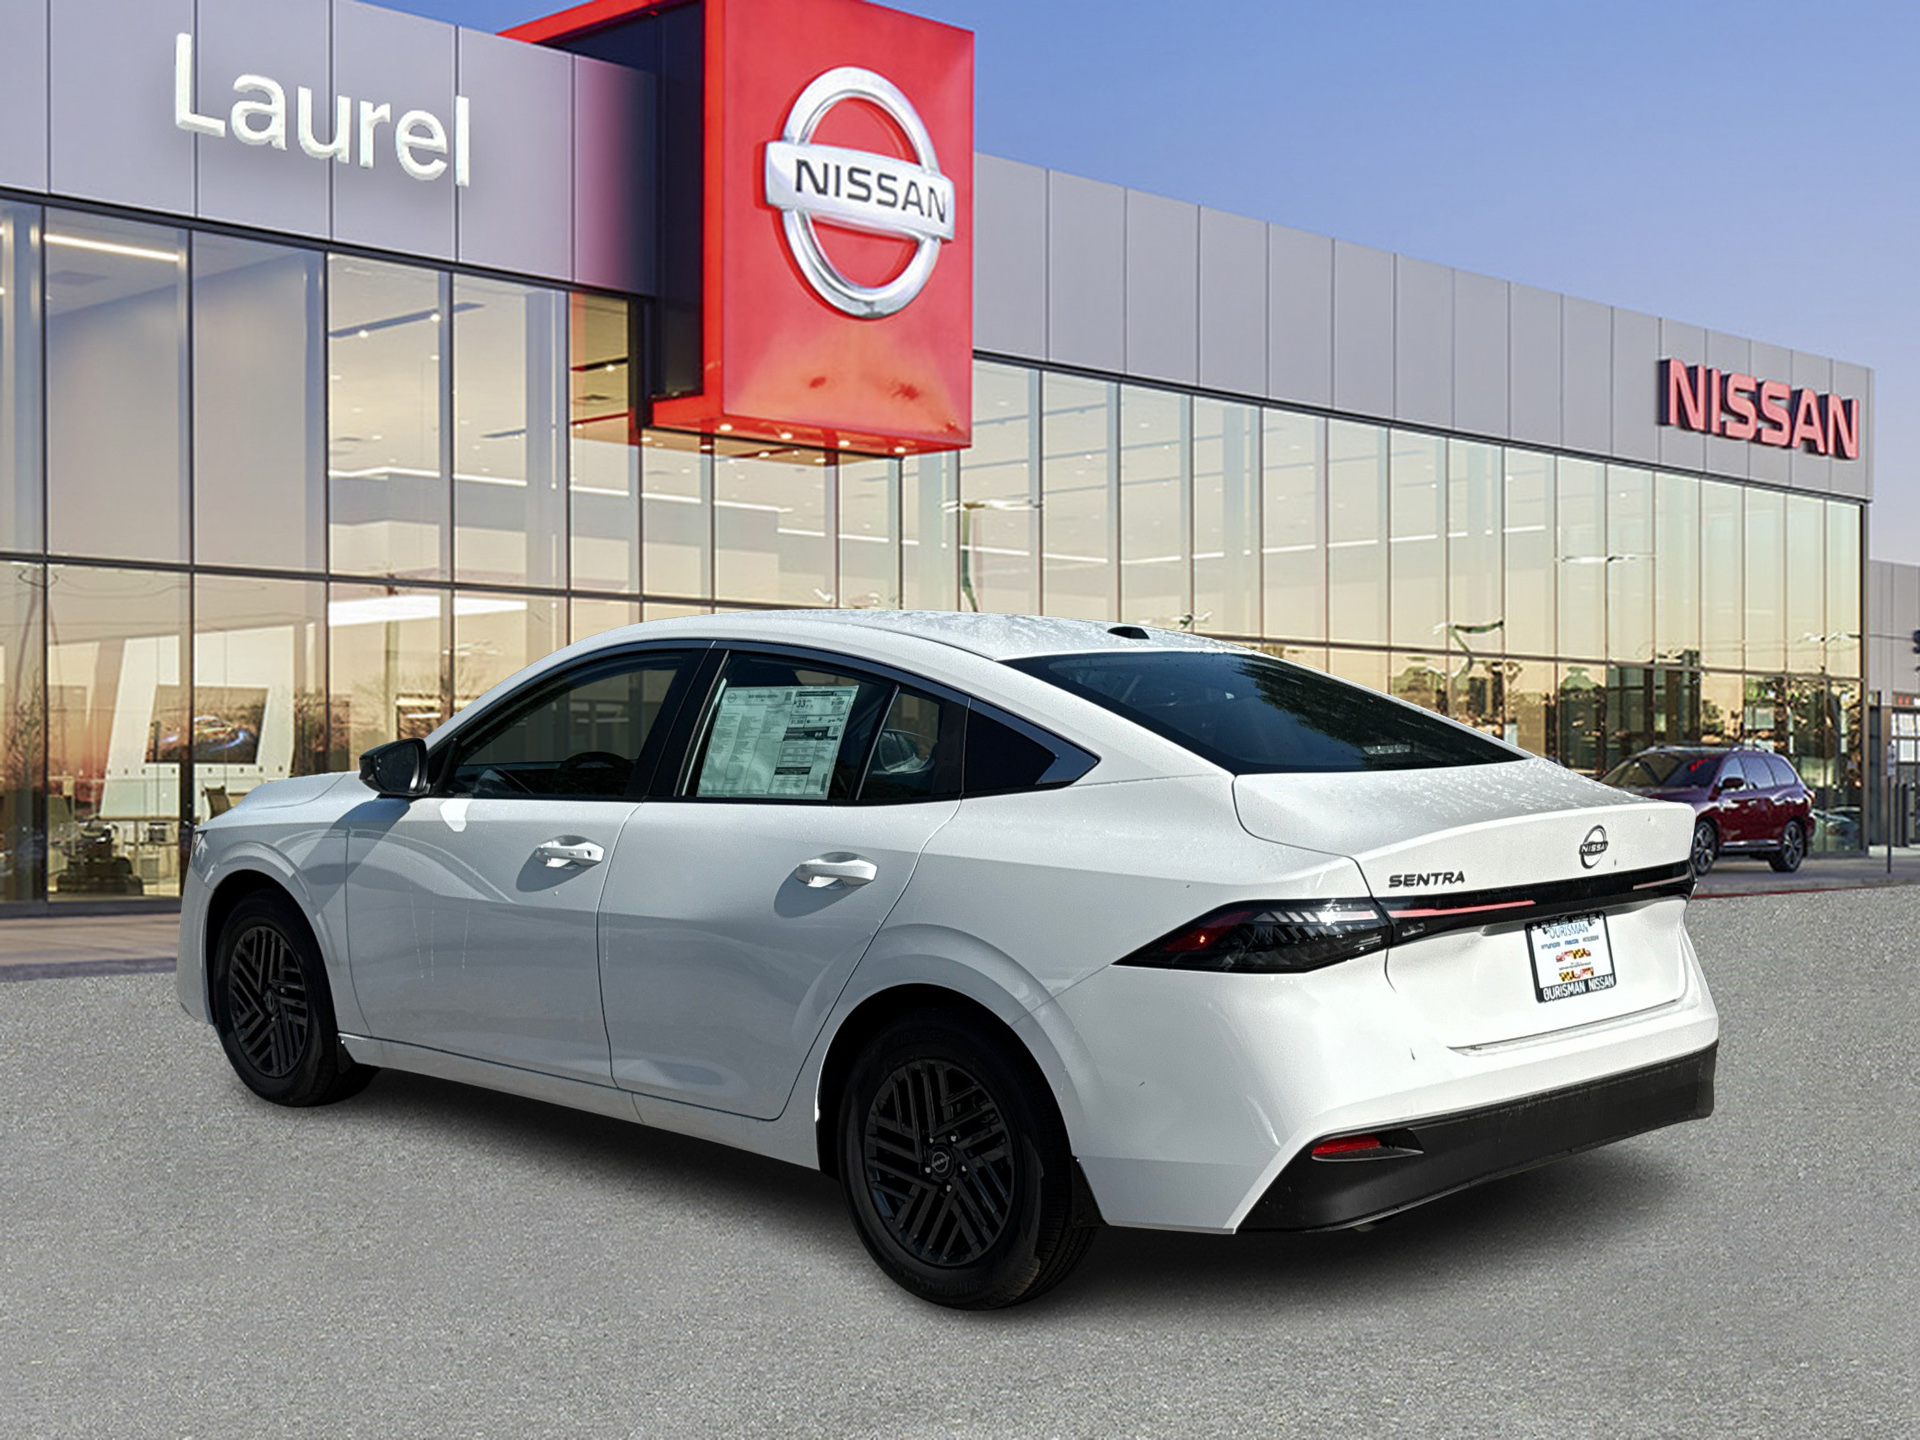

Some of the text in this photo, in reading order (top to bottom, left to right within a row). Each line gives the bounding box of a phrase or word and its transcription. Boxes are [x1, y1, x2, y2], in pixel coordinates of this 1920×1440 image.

[174, 33, 470, 187] Laurel
[796, 158, 947, 223] NISSAN
[1657, 358, 1860, 459] NISSAN
[1389, 871, 1465, 888] SENTRA
[1543, 975, 1614, 1001] OURISMAN NISSAN
